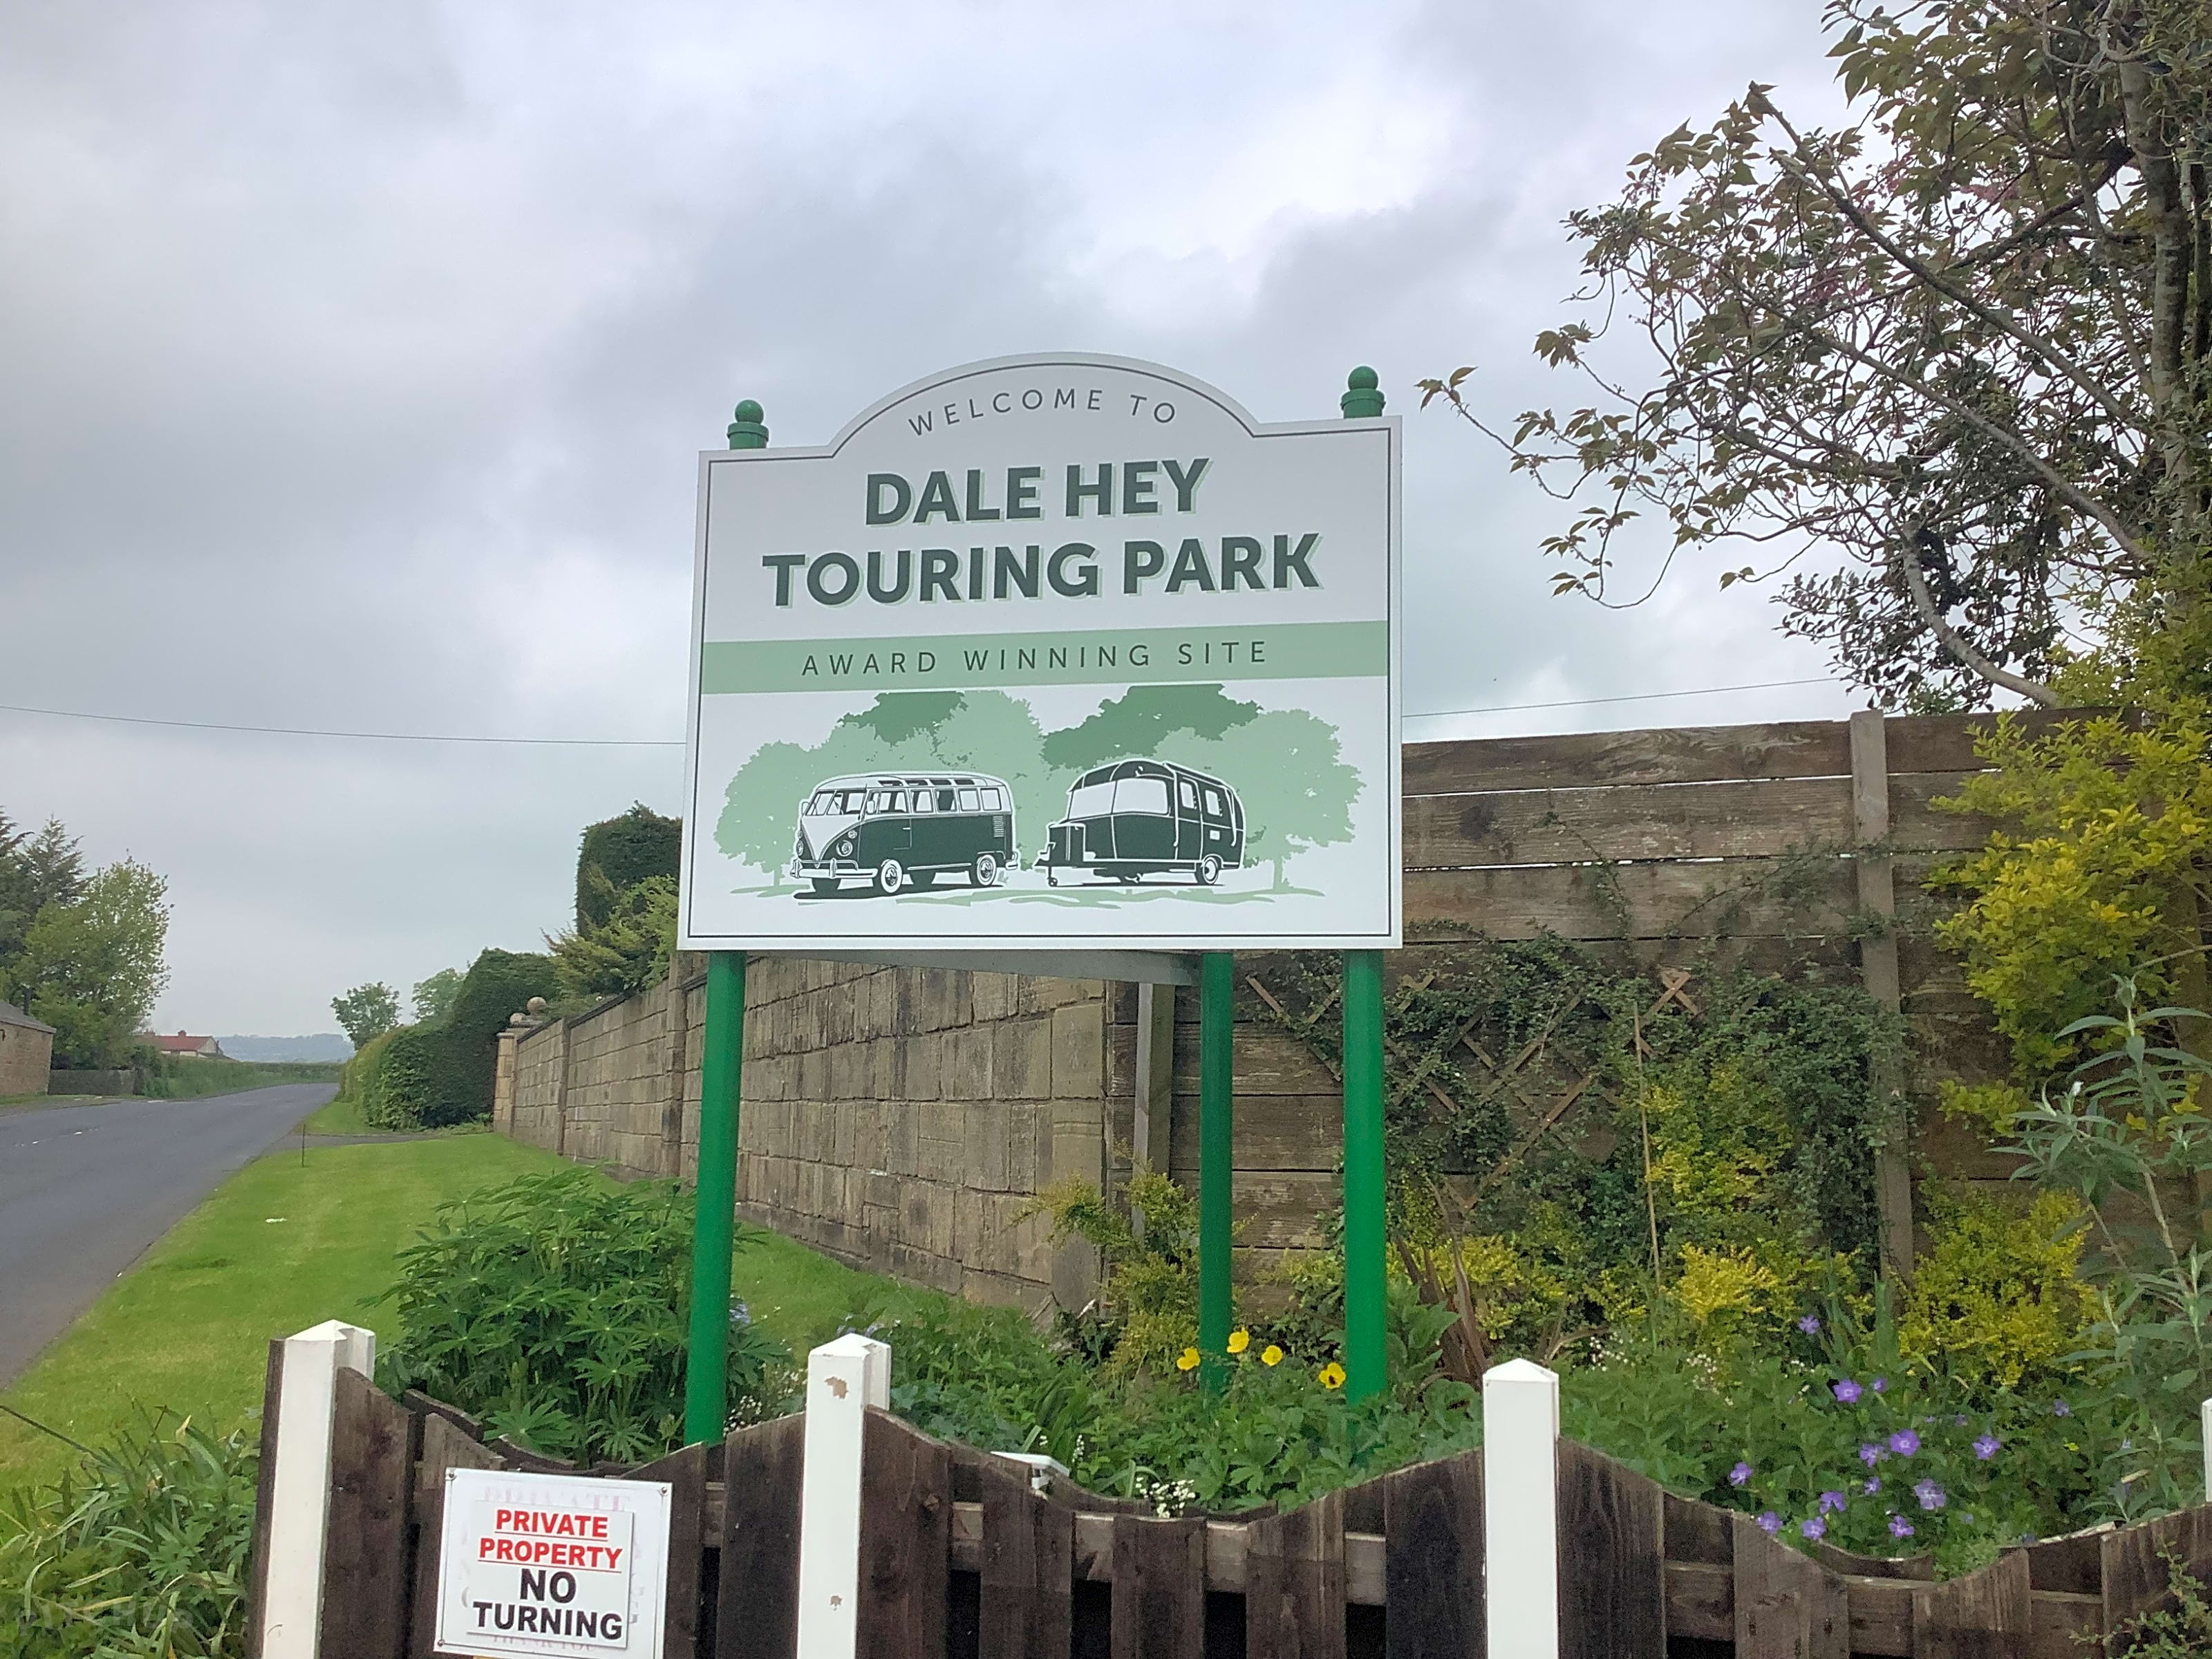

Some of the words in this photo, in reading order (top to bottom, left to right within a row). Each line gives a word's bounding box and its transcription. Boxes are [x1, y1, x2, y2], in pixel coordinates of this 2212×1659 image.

[908, 388, 1103, 437] WELCOME
[1130, 393, 1176, 424] TO
[865, 466, 1042, 525] DALE
[1065, 458, 1210, 517] HEY
[762, 543, 1099, 607] TOURING
[1123, 532, 1320, 594] PARK
[802, 651, 937, 676] AWARD
[964, 644, 1150, 671] WINNING
[1178, 640, 1266, 665] SITE
[496, 1509, 608, 1538] PRIVATE
[479, 1537, 623, 1569] PROPERTY
[519, 1568, 577, 1604] NO
[472, 1601, 623, 1641] TURNING
